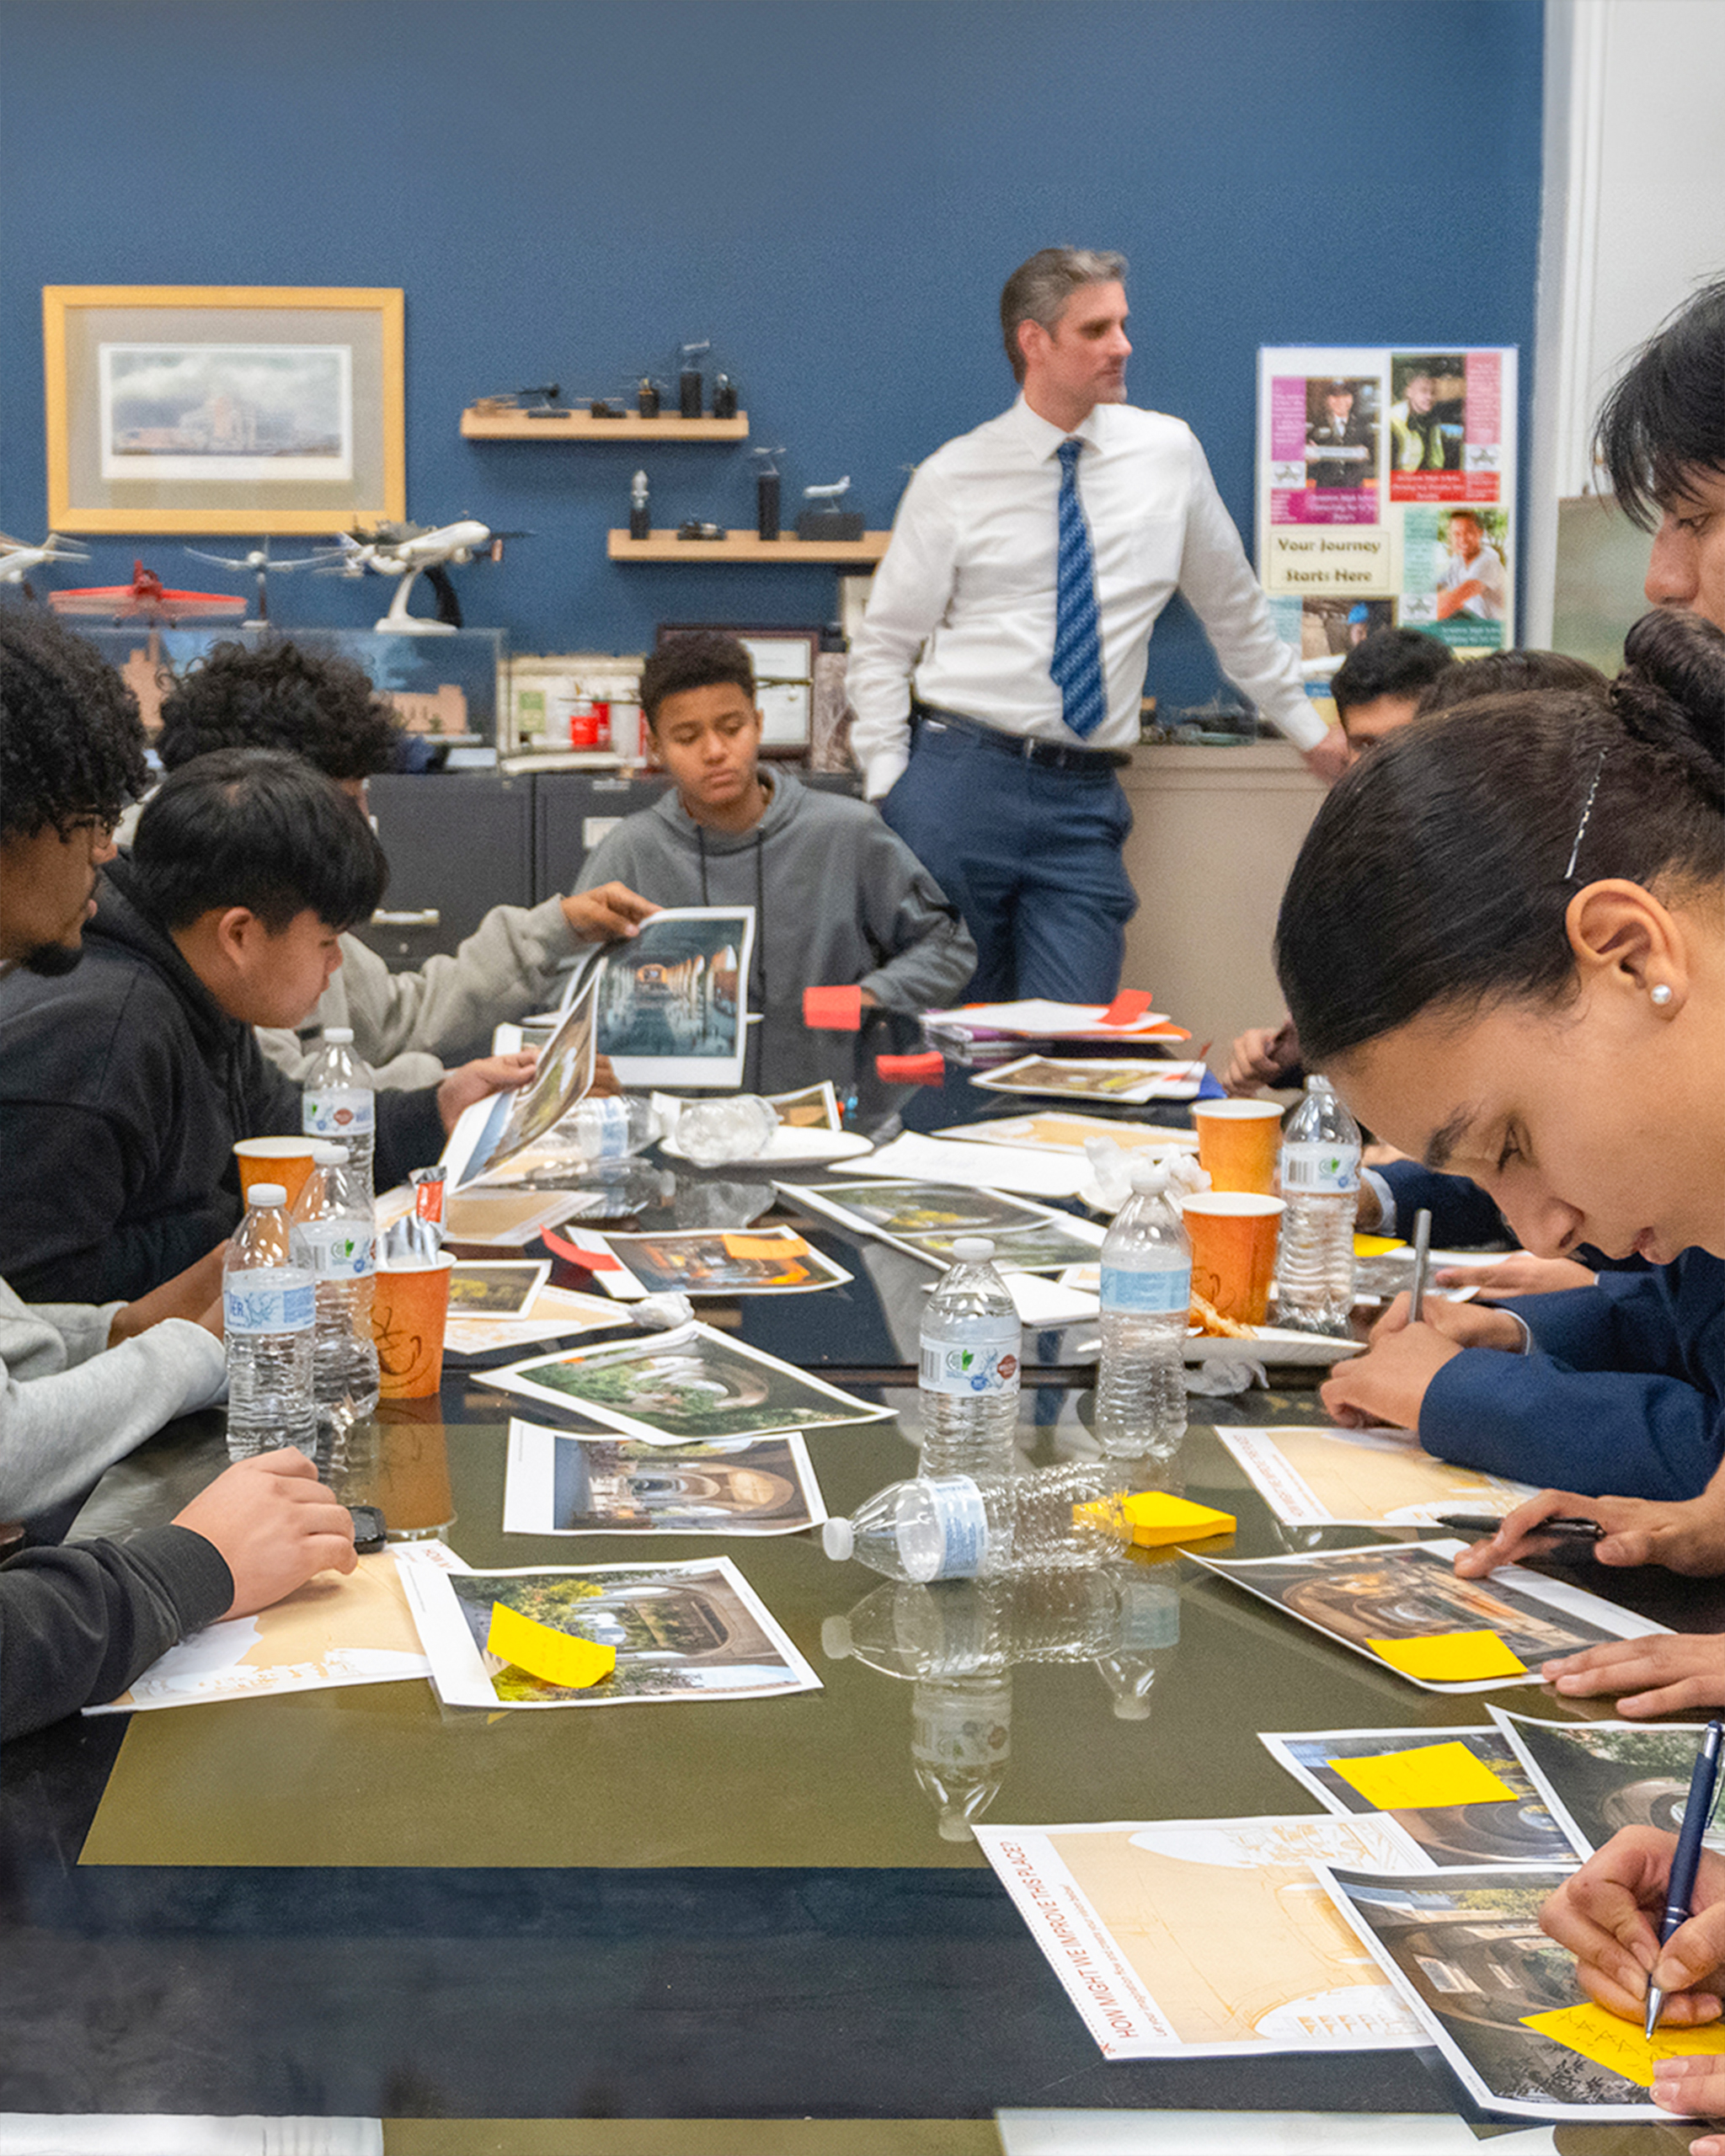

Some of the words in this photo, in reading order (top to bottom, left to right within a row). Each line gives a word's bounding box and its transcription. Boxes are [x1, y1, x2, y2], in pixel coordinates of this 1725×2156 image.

[1278, 537, 1315, 552] Your
[1321, 537, 1381, 554] Journey
[1286, 568, 1329, 582] Starts
[1334, 568, 1373, 582] Here
[999, 1840, 1038, 1876] PLACE?
[1022, 1877, 1051, 1900] THIS
[1036, 1900, 1081, 1947] IMPROVE
[1065, 1949, 1093, 1968] WE
[1077, 1968, 1119, 2006] MIGHT
[1102, 2008, 1139, 2038] HOW
[1152, 2025, 1168, 2037] Let
